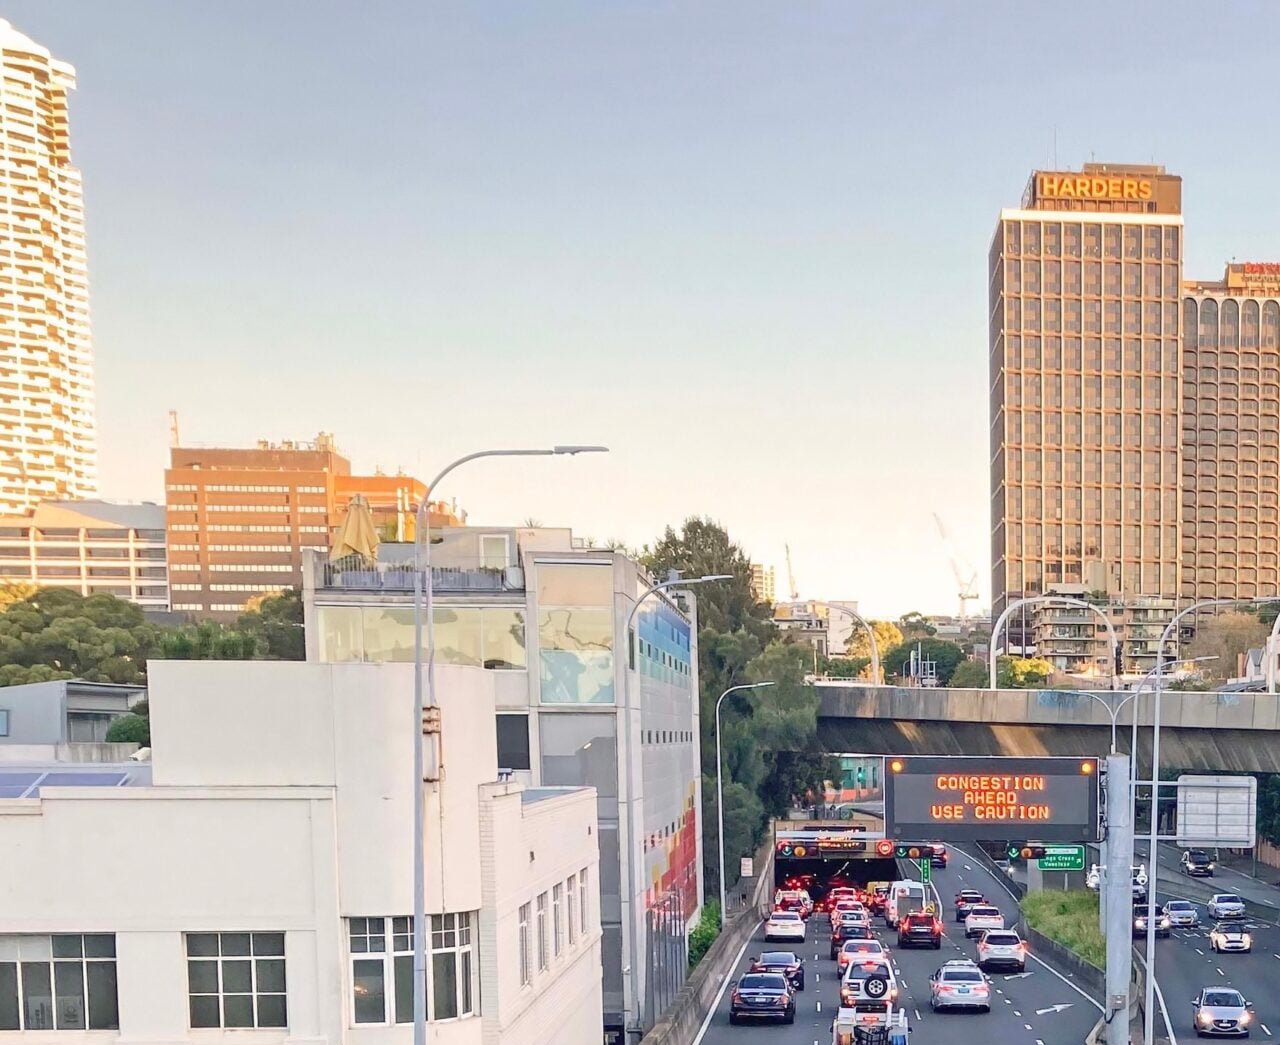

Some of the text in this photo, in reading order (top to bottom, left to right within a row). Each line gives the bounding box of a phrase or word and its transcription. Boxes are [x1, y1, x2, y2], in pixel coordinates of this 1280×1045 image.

[1043, 176, 1153, 199] HARDERS
[937, 776, 1044, 790] CONGESTION
[964, 791, 1017, 805] AHEAD
[932, 805, 1049, 819] USE CAUTION
